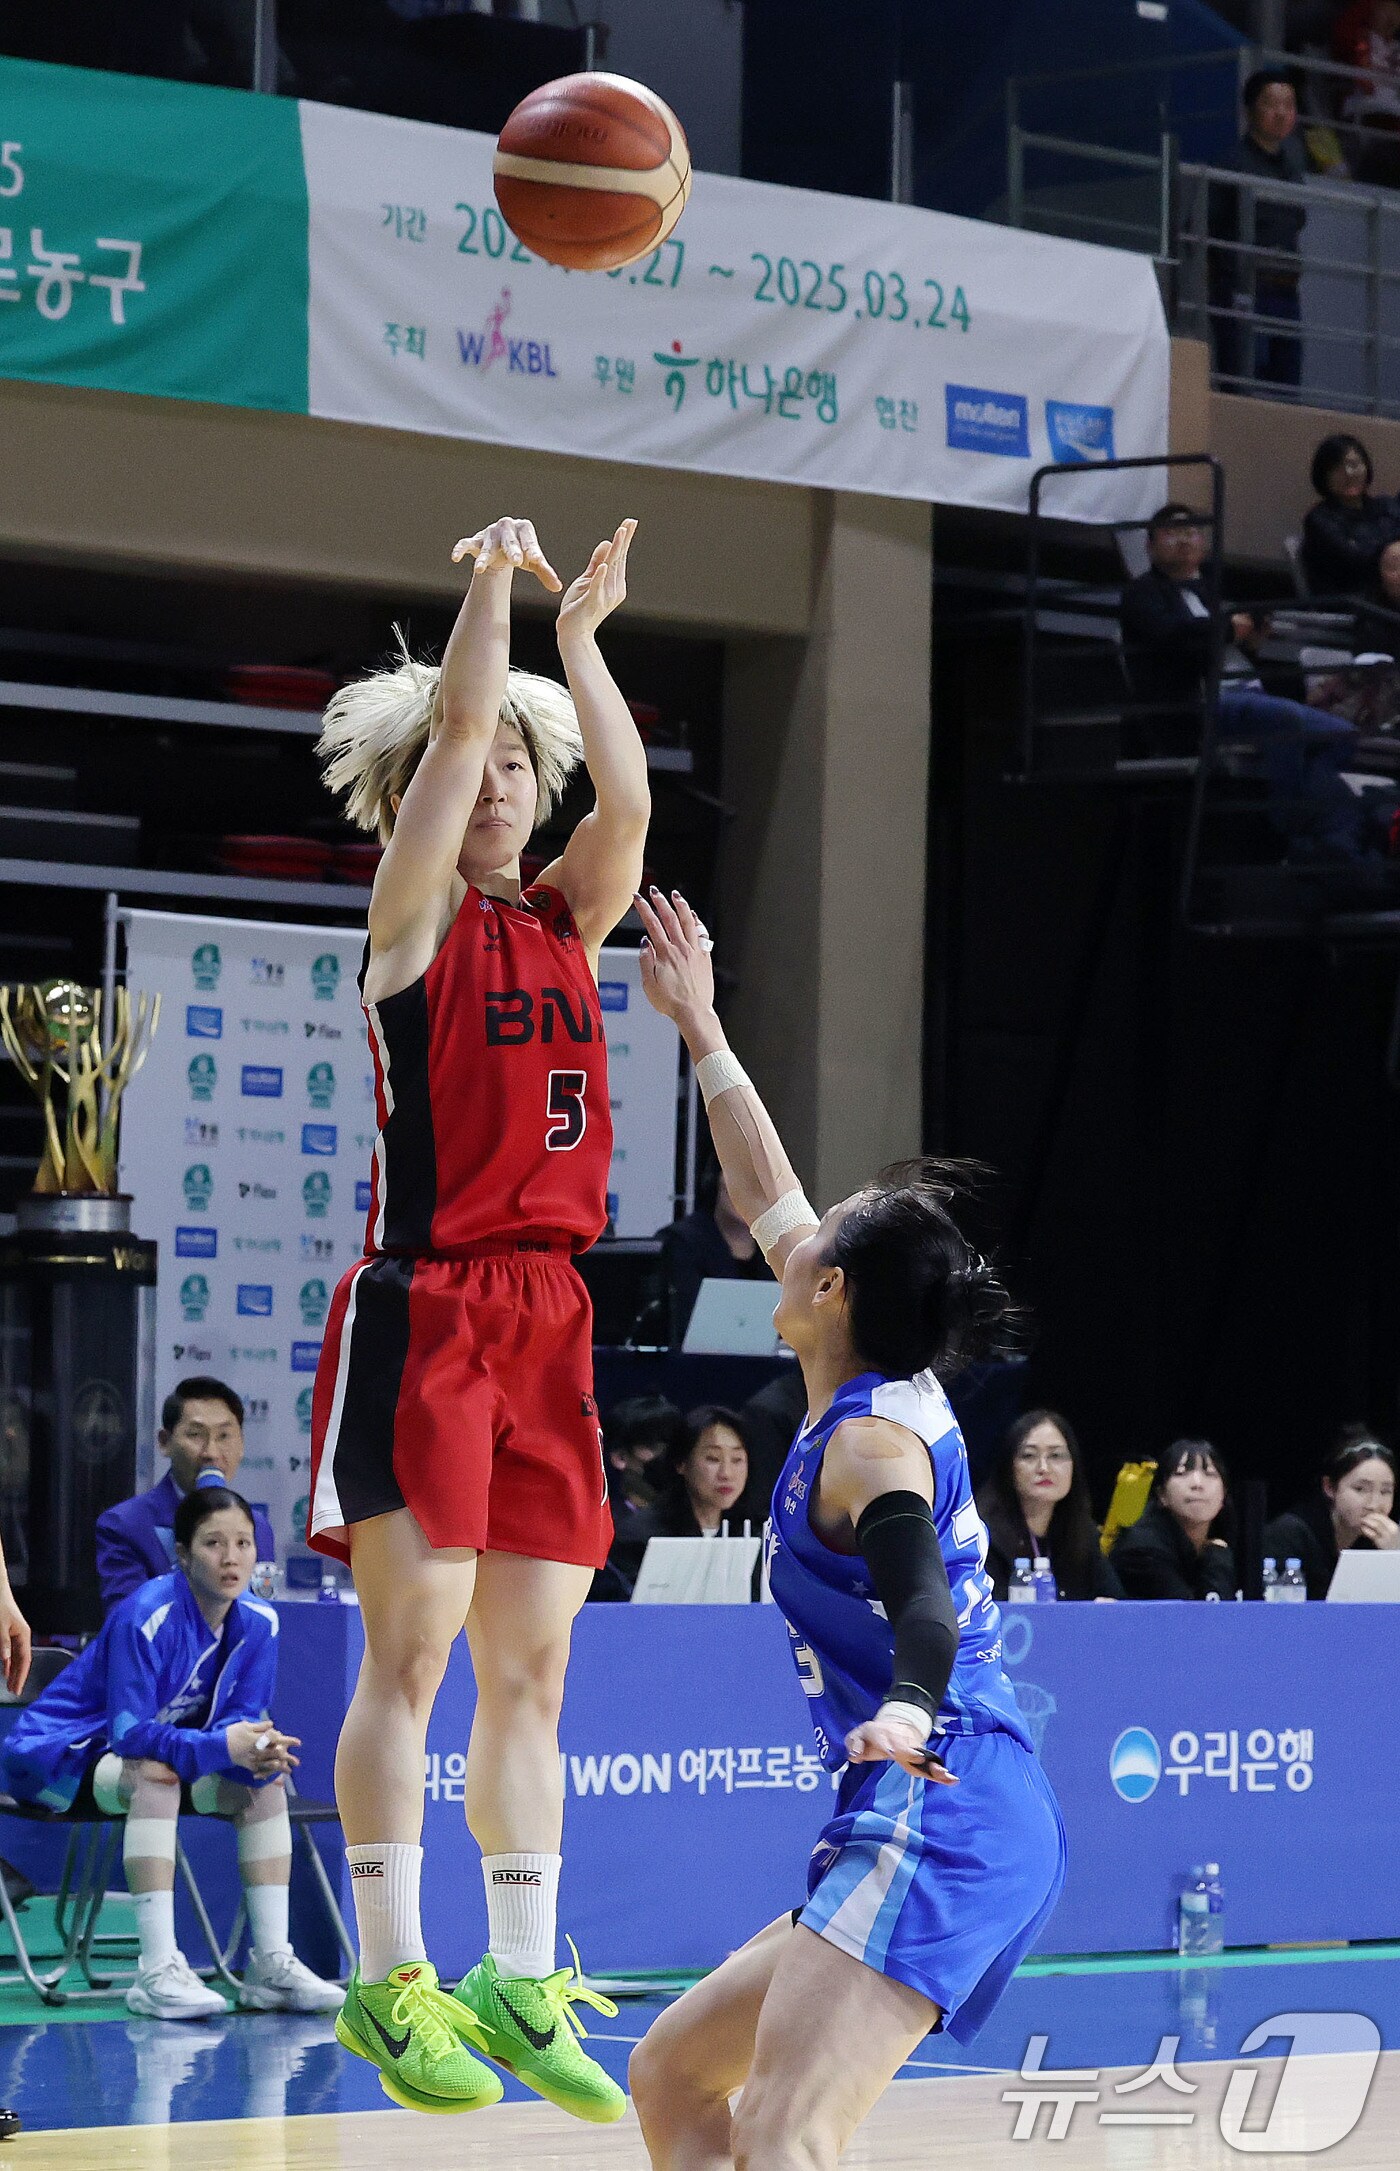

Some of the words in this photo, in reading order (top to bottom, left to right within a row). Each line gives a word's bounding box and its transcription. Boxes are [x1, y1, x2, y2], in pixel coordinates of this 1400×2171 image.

[382, 203, 427, 243] 기간
[751, 252, 971, 333] 2025.03.24
[384, 322, 427, 360] 주최
[706, 358, 838, 424] 하나은행
[545, 1069, 587, 1151] 5
[1164, 1728, 1315, 1797] 우리은행
[492, 1872, 541, 1884] BNK
